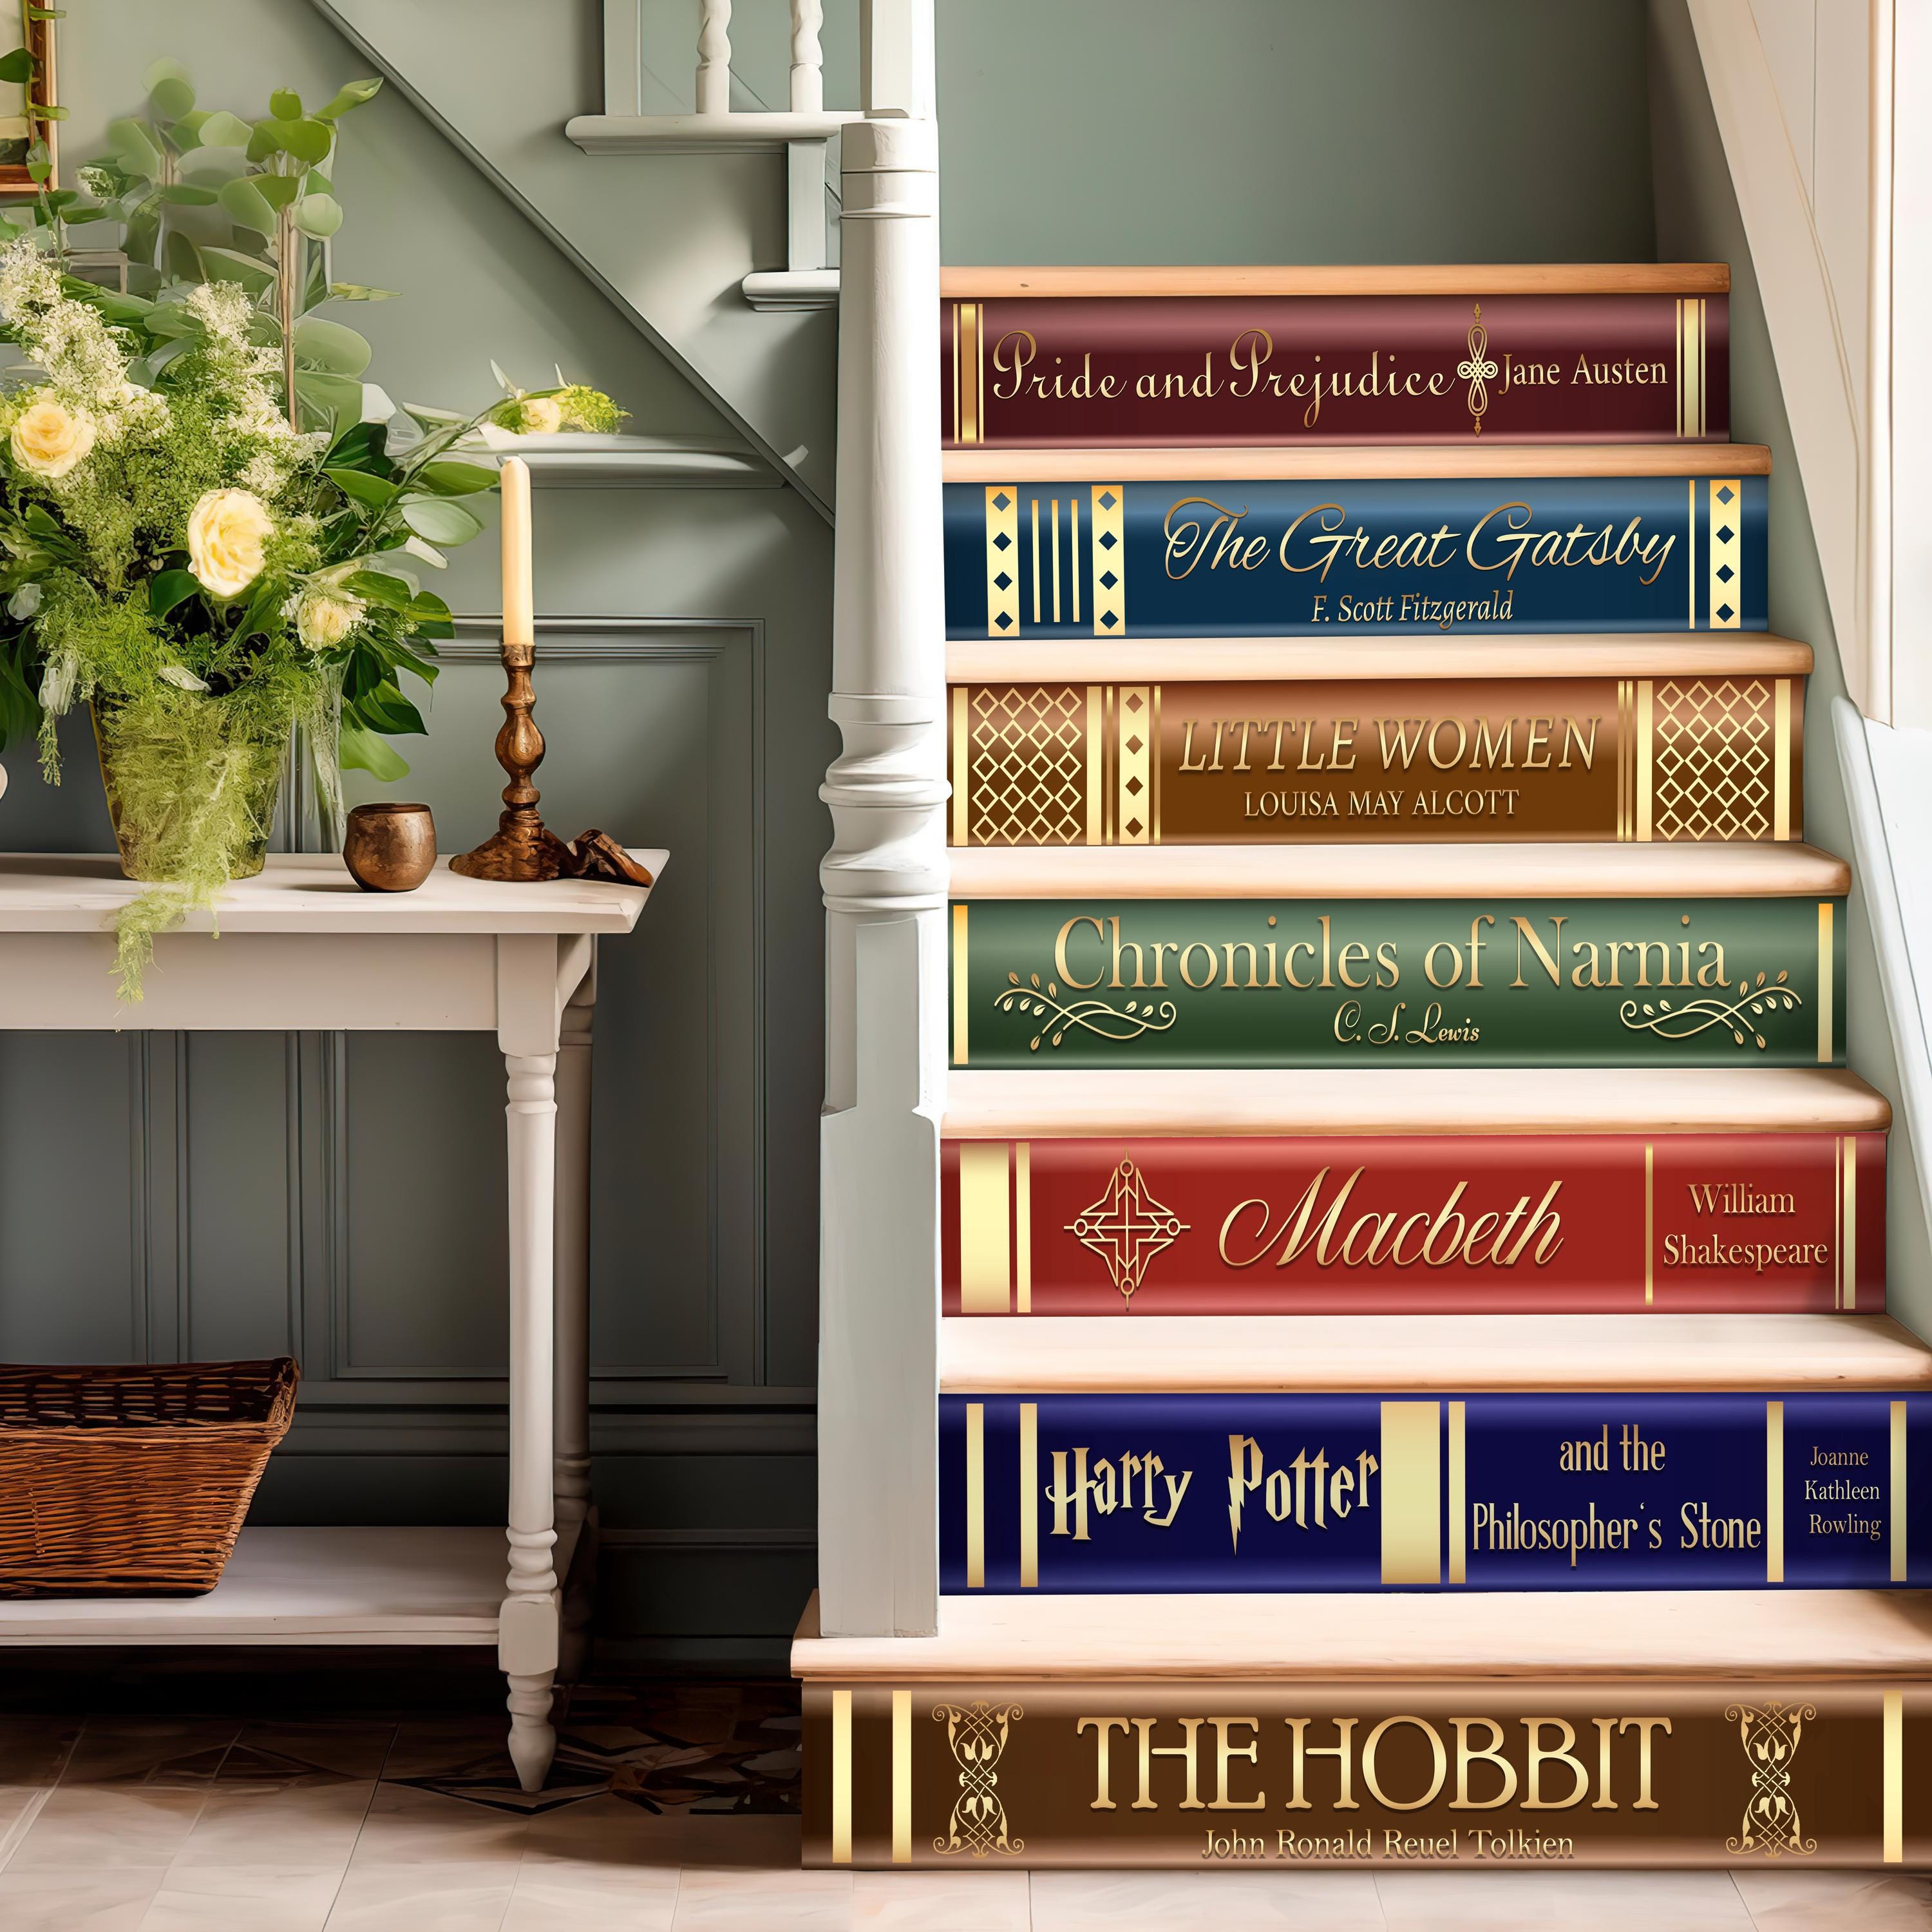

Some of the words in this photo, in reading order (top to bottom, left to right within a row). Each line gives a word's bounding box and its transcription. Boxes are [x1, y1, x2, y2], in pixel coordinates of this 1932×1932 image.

[992, 329, 1127, 400] Pride
[1135, 351, 1224, 400] and
[1229, 328, 1455, 428] Prejudice
[1498, 354, 1561, 395] Jane
[1570, 352, 1669, 386] Austen
[1164, 497, 1270, 580] The
[1279, 502, 1460, 583] Great
[1466, 501, 1676, 585] Gatsby
[1311, 594, 1331, 623] F.
[1338, 592, 1394, 623] Scott
[1399, 590, 1514, 630] Fitzgerald
[1178, 718, 1360, 772] LITTLE
[1374, 715, 1601, 770] WOMEN
[1244, 790, 1339, 818] LOUISA
[1347, 790, 1406, 817] MAY
[1412, 788, 1519, 817] ALCOTT
[1053, 914, 1399, 989] Chronicles
[1424, 914, 1494, 989] of
[1508, 914, 1732, 989] Narnia
[1332, 999, 1361, 1044] C.
[1368, 1002, 1406, 1044] S.
[1406, 1002, 1481, 1045] Lewis
[1218, 1166, 1564, 1266] Macbeth
[1687, 1182, 1795, 1215] William
[1663, 1233, 1829, 1271] Shakespeare
[1558, 1425, 1609, 1472] and
[1619, 1425, 1667, 1471] the
[1810, 1445, 1869, 1468] Joanne
[1045, 1446, 1193, 1540] Harry
[1228, 1434, 1379, 1556] Potter
[1804, 1480, 1880, 1502] Kathleen
[1680, 1501, 1762, 1549] Stone
[1808, 1513, 1882, 1540] Rowling
[1077, 1716, 1265, 1810] THE
[1287, 1716, 1672, 1810] HOBBIT
[1201, 1829, 1266, 1859] John
[1274, 1828, 1373, 1859] Ronald
[1383, 1828, 1459, 1859] Reuel
[1467, 1828, 1575, 1859] Tolkien
